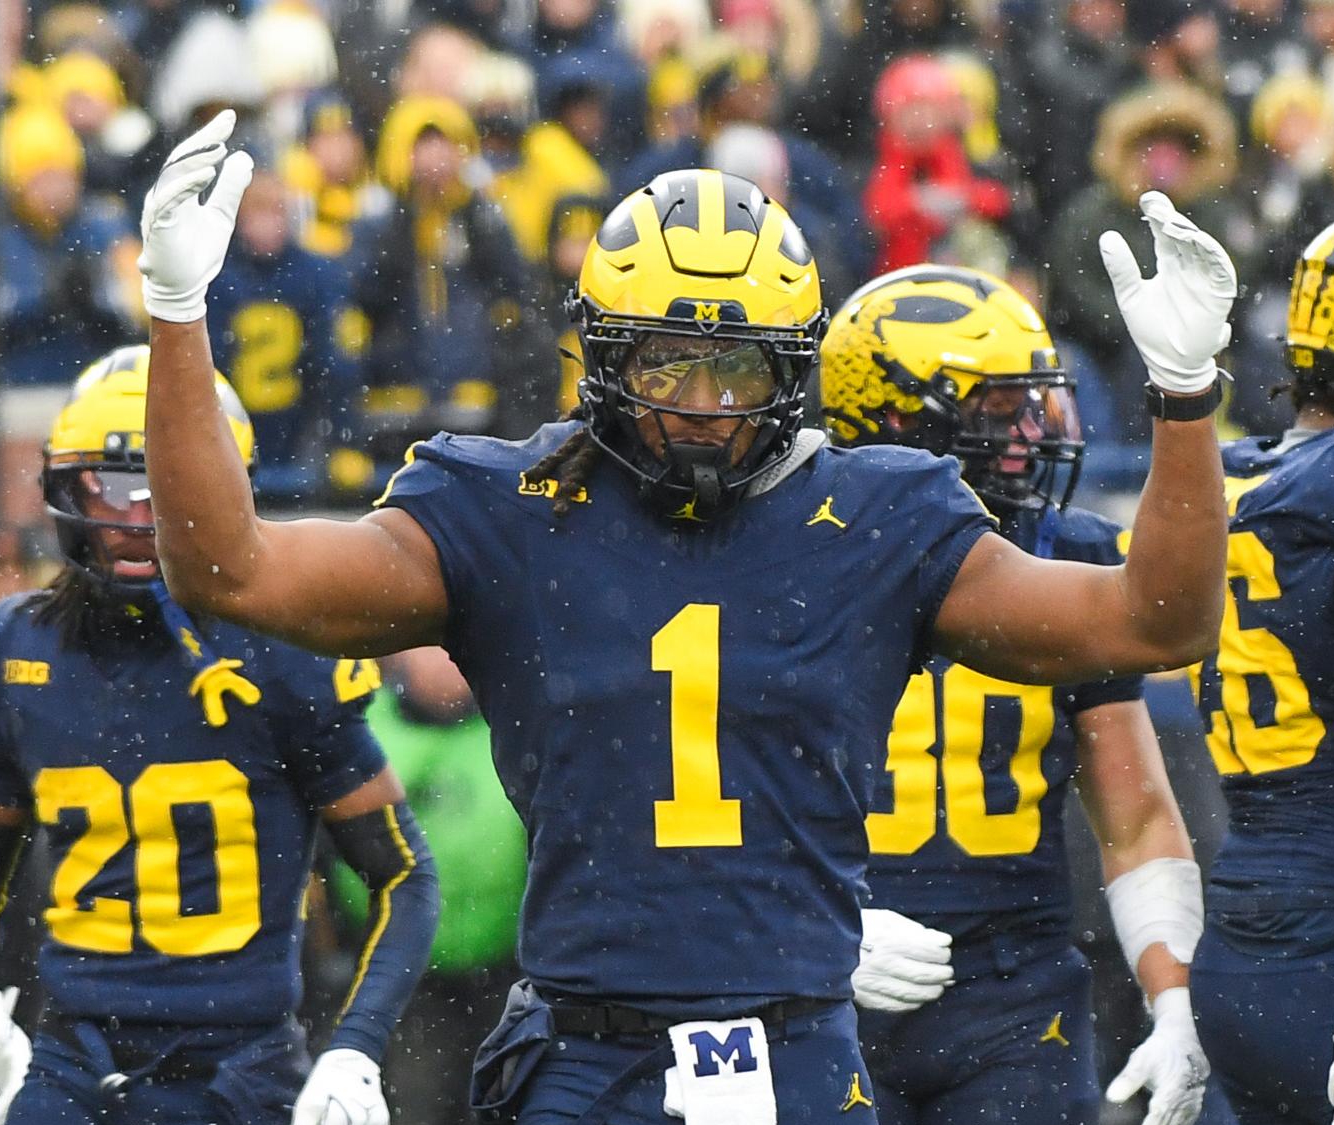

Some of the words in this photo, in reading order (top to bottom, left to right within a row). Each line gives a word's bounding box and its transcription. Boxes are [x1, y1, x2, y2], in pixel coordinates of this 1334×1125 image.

[231, 303, 304, 412] 2
[694, 301, 720, 321] M
[650, 603, 744, 848] 1
[1189, 530, 1327, 776] 6
[32, 759, 263, 957] 20
[688, 1026, 758, 1077] M
